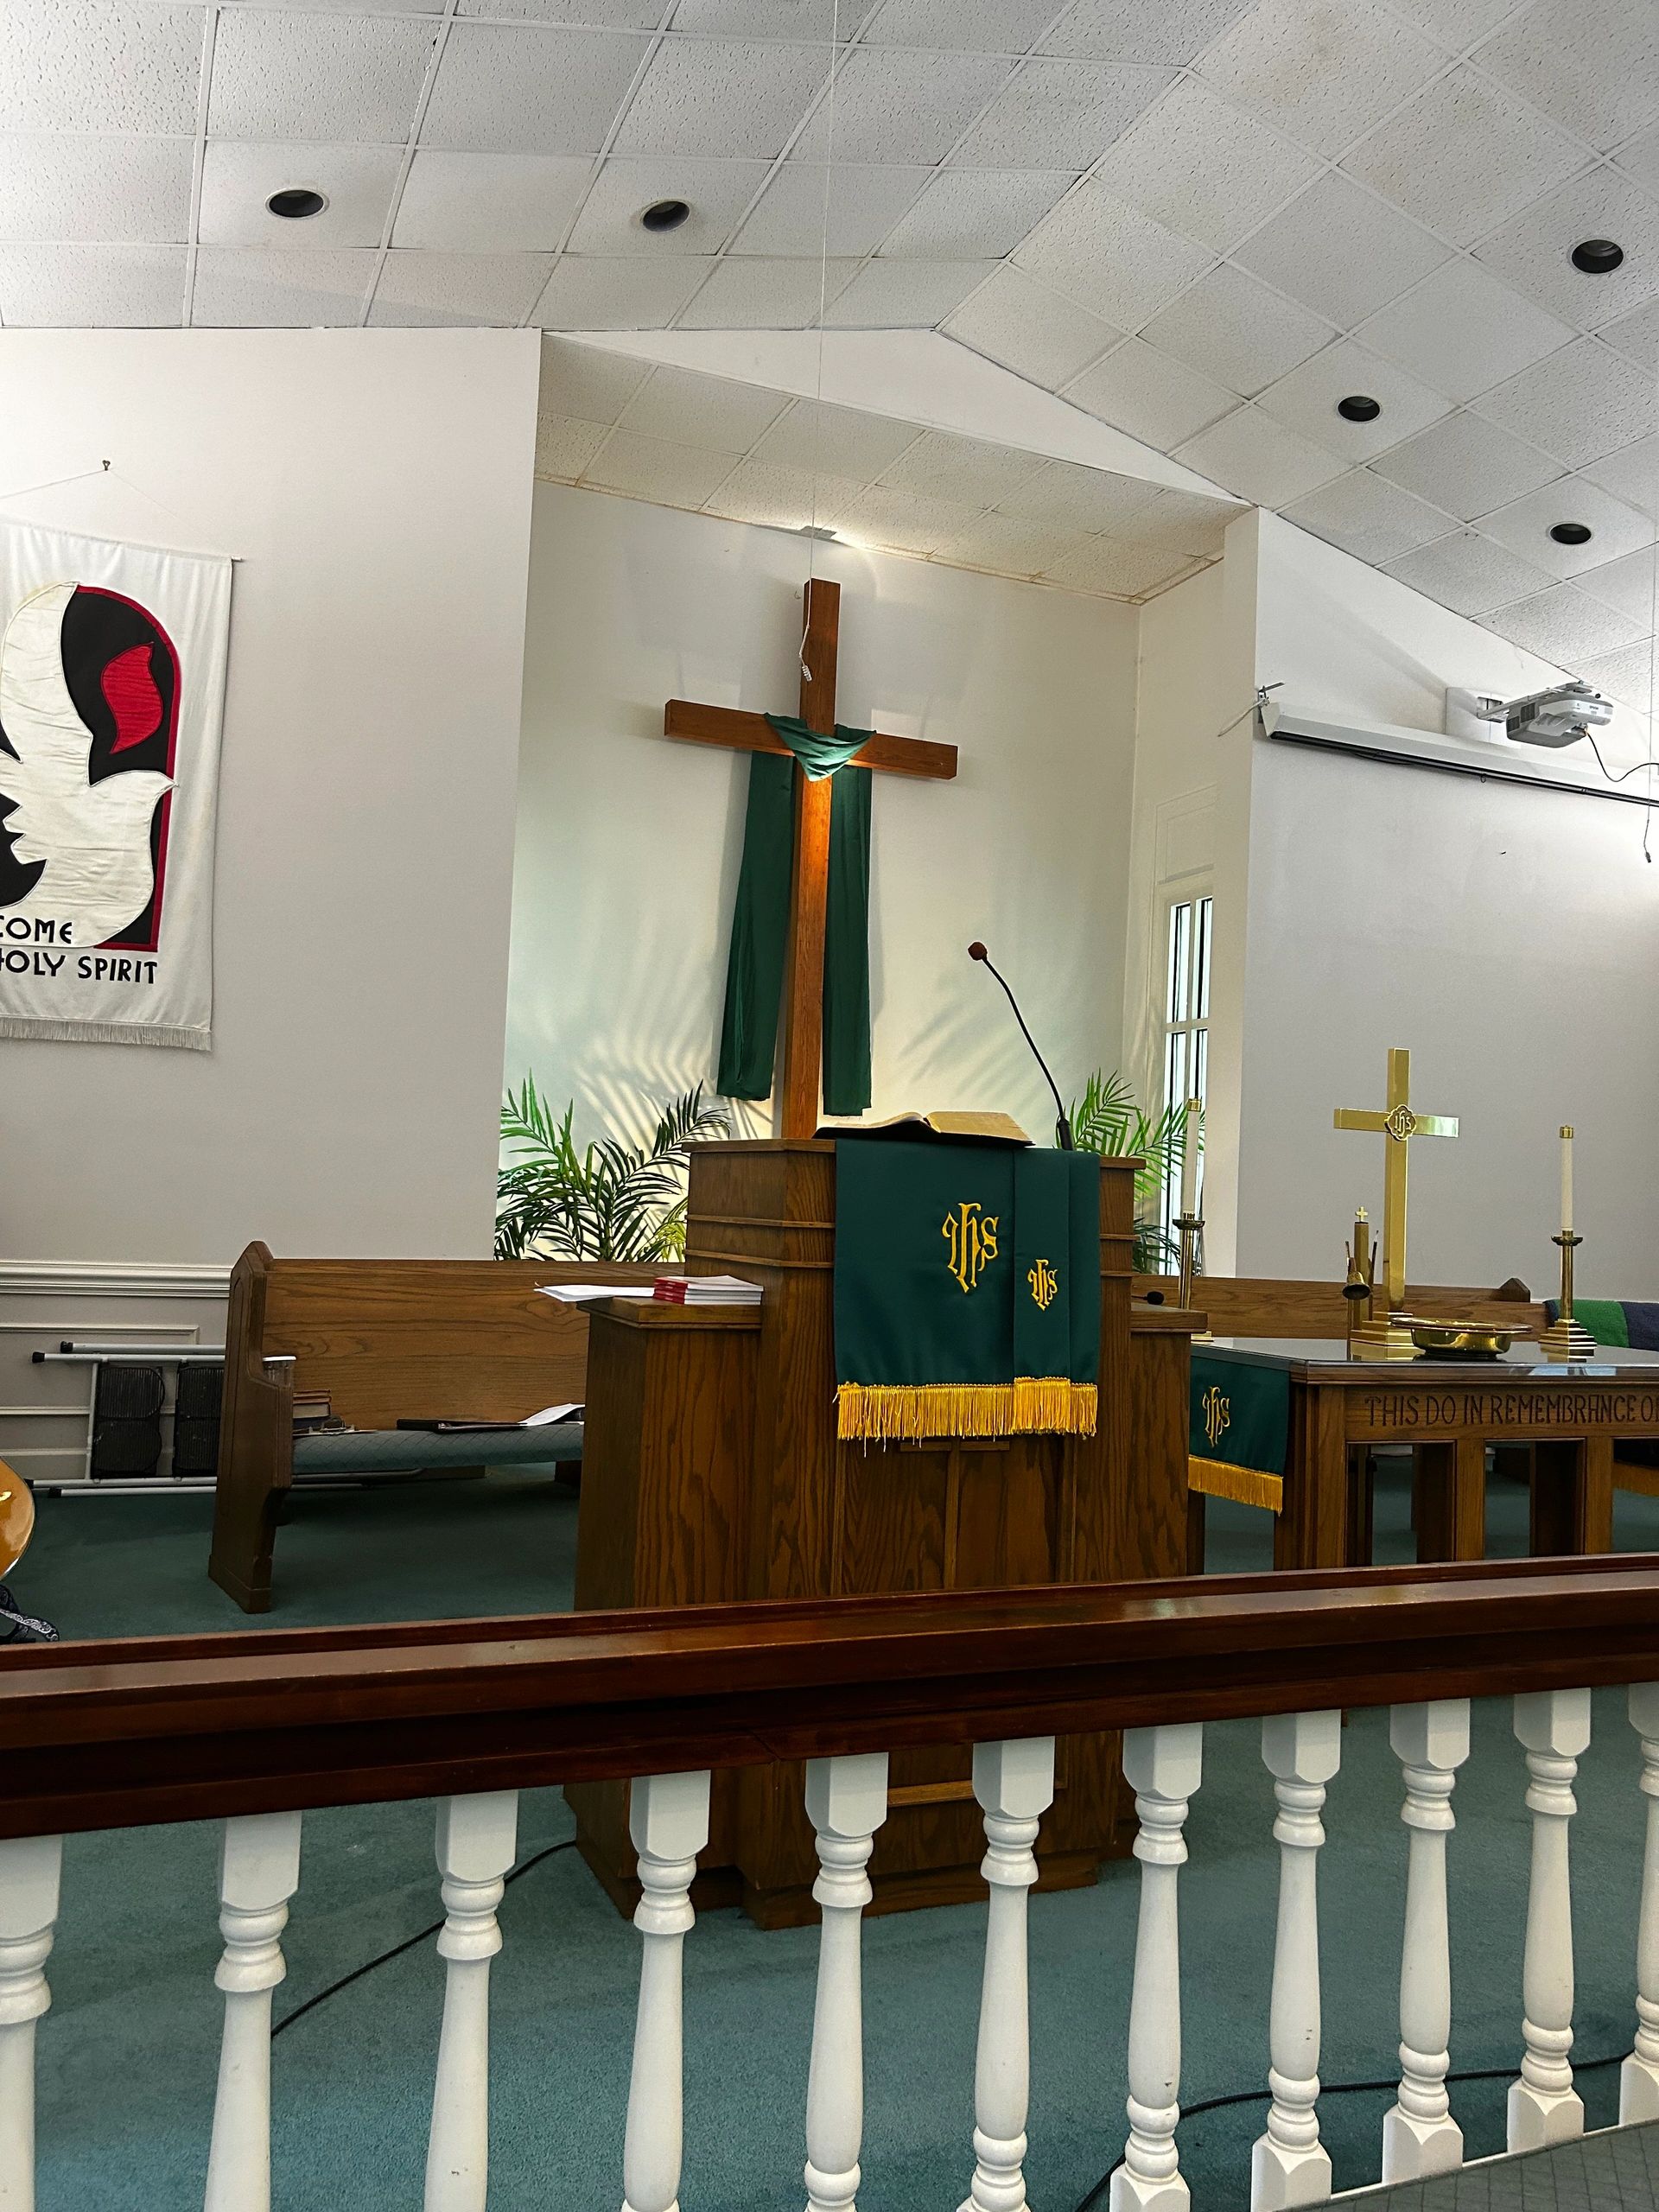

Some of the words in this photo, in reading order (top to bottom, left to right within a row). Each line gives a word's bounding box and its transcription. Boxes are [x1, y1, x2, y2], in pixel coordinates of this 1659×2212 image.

[0, 915, 73, 944] OME
[78, 956, 157, 984] SPIRIT
[1364, 1395, 1419, 1426] THIS
[1427, 1395, 1456, 1425] DO
[1464, 1395, 1483, 1425] IN
[1491, 1395, 1637, 1424] REMEMBRANCE
[1641, 1395, 1659, 1422] O
